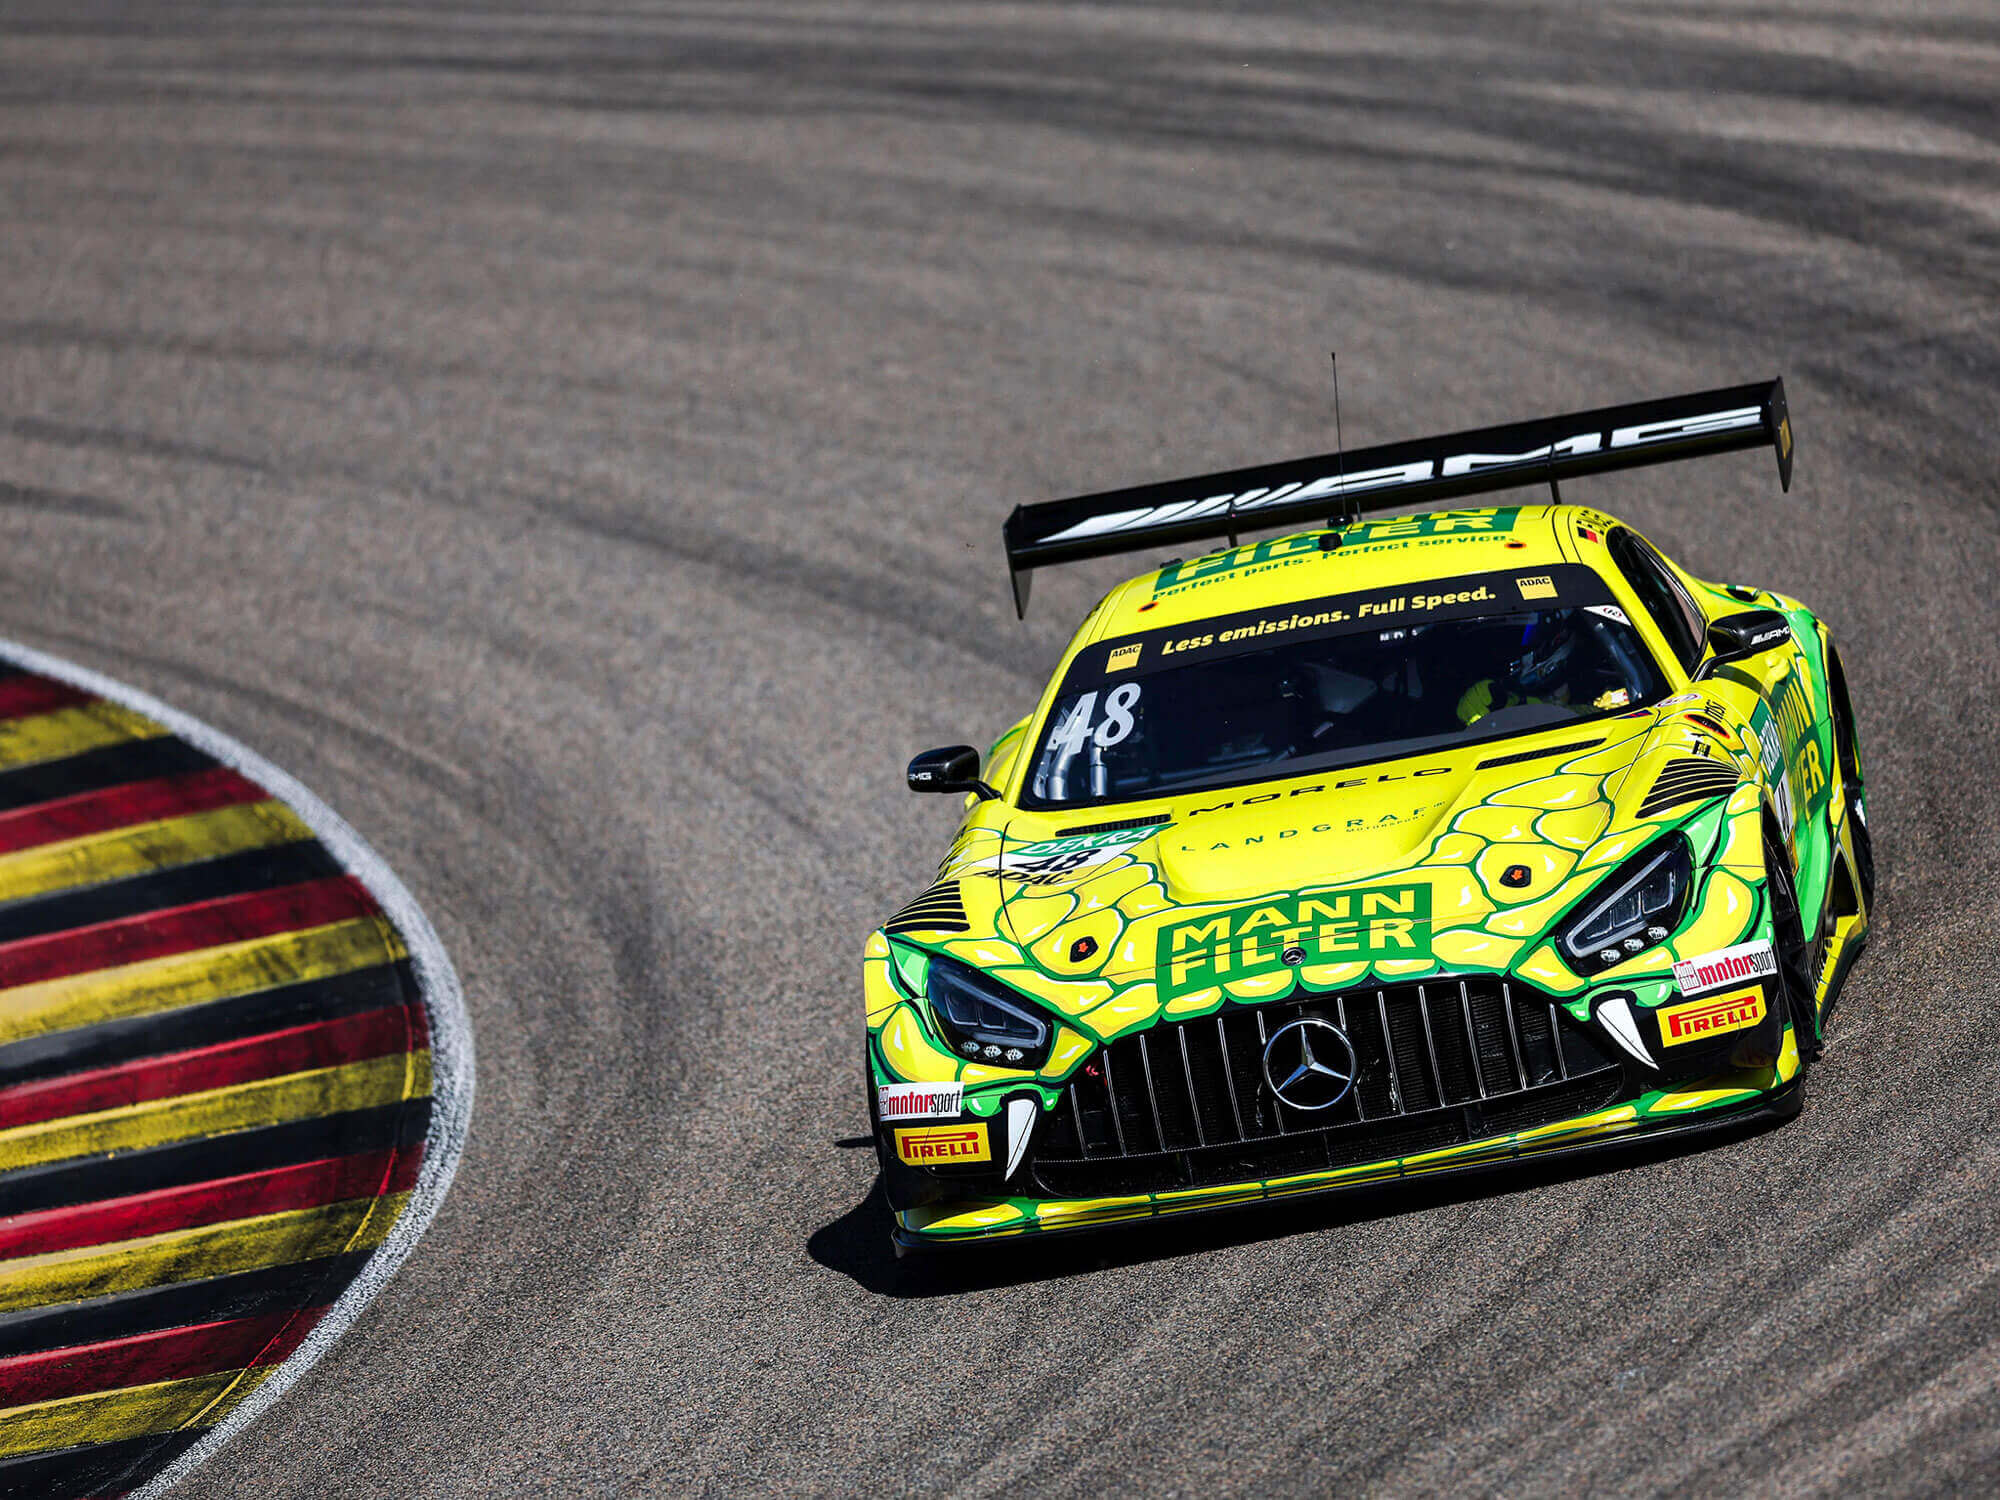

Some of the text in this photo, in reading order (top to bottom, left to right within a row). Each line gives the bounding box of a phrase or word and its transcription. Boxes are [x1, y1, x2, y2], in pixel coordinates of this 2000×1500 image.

[1152, 572, 1235, 601] Perfect
[1245, 558, 1313, 577] parts.
[1322, 541, 1408, 559] Perfect
[1519, 577, 1550, 587] ADAC
[1161, 586, 1496, 655] Less emissions. Full Speed.
[1111, 645, 1139, 658] ADAC
[1046, 682, 1141, 755] 48
[1189, 768, 1452, 816] MORELO
[1025, 825, 1155, 854] DEKRA
[1181, 806, 1428, 851] LANDGRAF
[1010, 848, 1103, 872] 48
[1173, 890, 1415, 952] MANN
[1172, 918, 1417, 986] FILTER
[1697, 946, 1776, 986] motorsport
[1668, 995, 1758, 1038] PIRELLI
[888, 1090, 961, 1116] motorsport
[902, 1132, 980, 1158] PIRELLI
